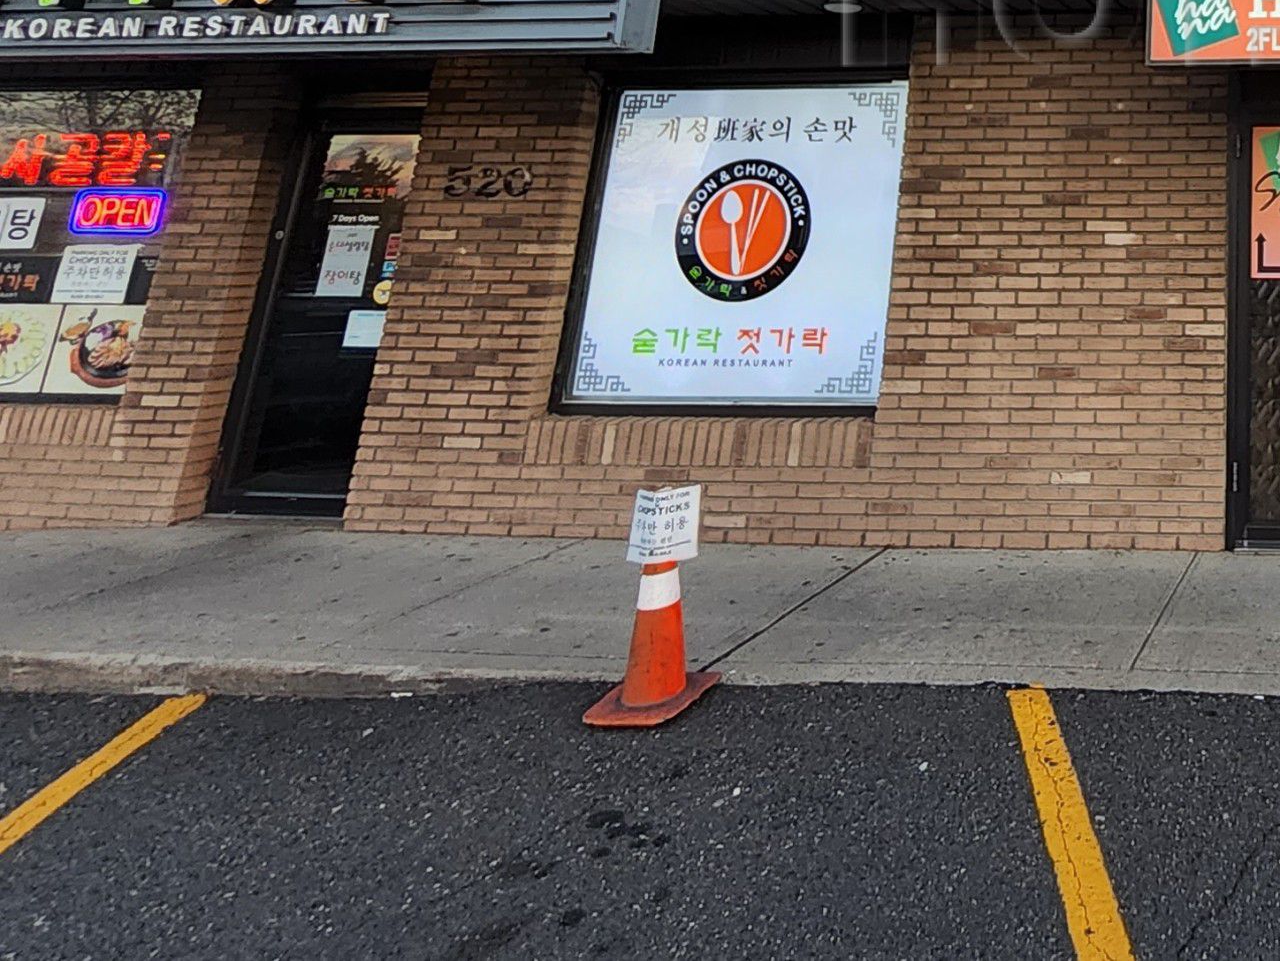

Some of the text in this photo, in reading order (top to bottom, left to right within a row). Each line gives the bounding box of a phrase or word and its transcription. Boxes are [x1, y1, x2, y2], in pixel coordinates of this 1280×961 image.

[3, 12, 390, 39] KOREAN RESTAURANT
[803, 116, 857, 143] 손맛
[444, 165, 533, 198] 520
[79, 197, 157, 226] OPEN
[680, 163, 806, 236] SPOON & CHOPSTICK
[338, 214, 356, 223] Days
[358, 214, 380, 223] Open
[69, 256, 127, 264] CHOPSTICKS
[632, 326, 828, 355] 숟가락 젓가락
[658, 359, 793, 367] KOREAN RESTAURANT
